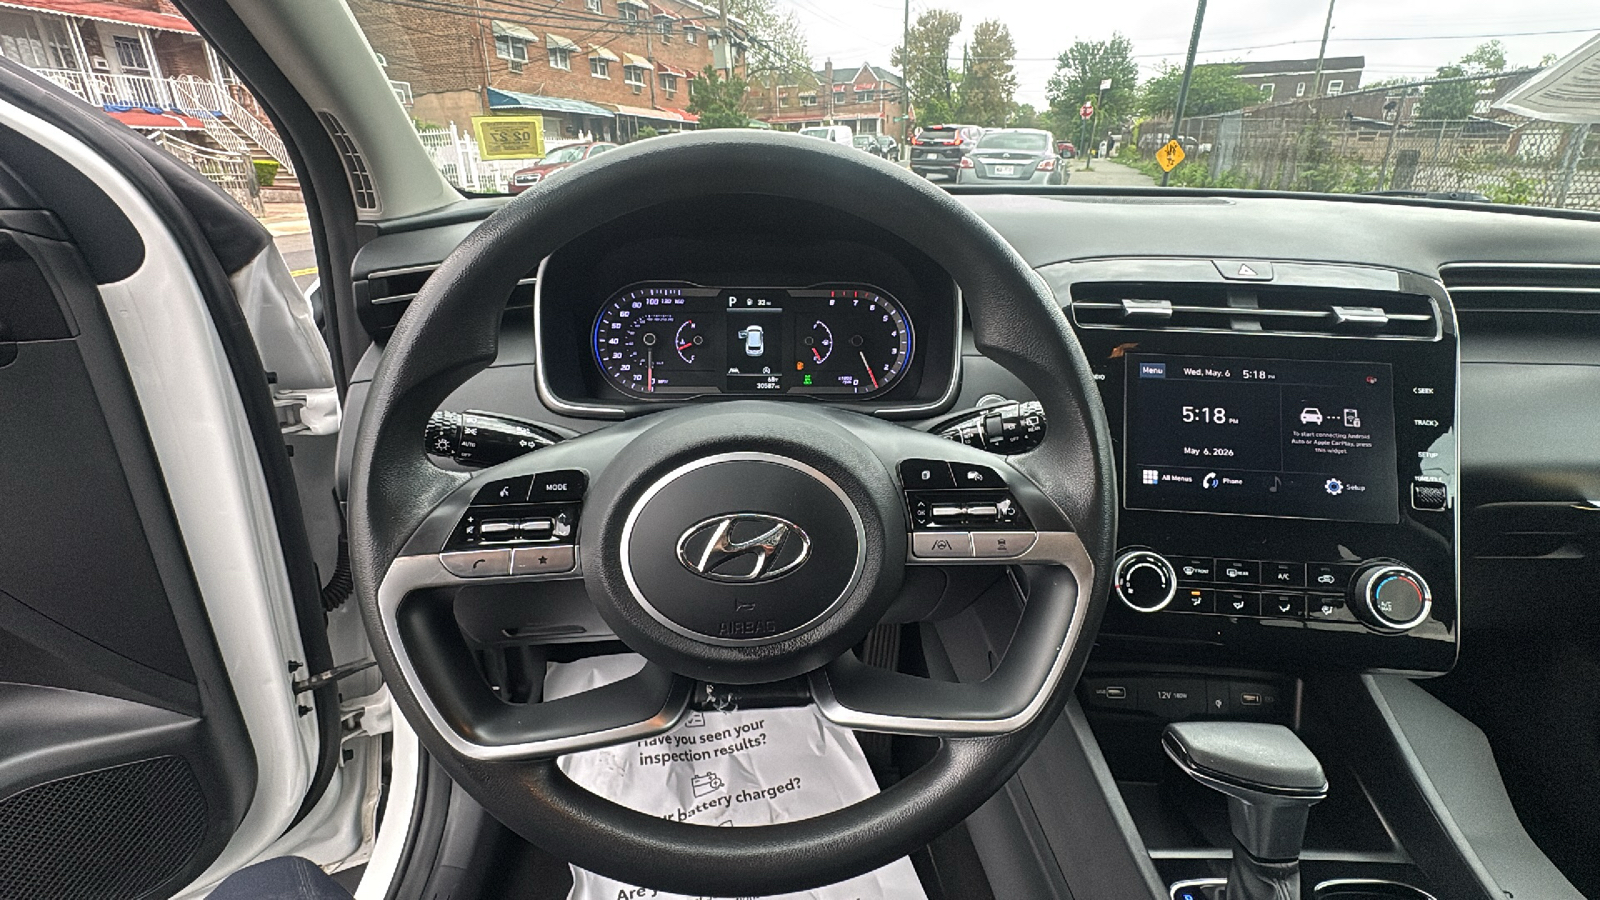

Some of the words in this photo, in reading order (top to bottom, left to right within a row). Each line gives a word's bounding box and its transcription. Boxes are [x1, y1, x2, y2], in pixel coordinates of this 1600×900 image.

[729, 296, 737, 307] P
[1142, 366, 1163, 374] Menu
[1205, 369, 1224, 377] May.
[1225, 369, 1231, 377] 6
[1242, 370, 1266, 379] 5:18
[1182, 406, 1226, 424] 5:18
[1183, 447, 1200, 456] May
[1213, 448, 1234, 456] 2026
[720, 621, 776, 635] AIRBAG
[674, 735, 697, 748] you
[699, 729, 732, 742] seen
[734, 719, 765, 738] your
[639, 750, 711, 766] inspection
[714, 732, 767, 757] results?
[677, 793, 732, 821] battery
[735, 777, 801, 803] charged?
[617, 888, 646, 900] Are
